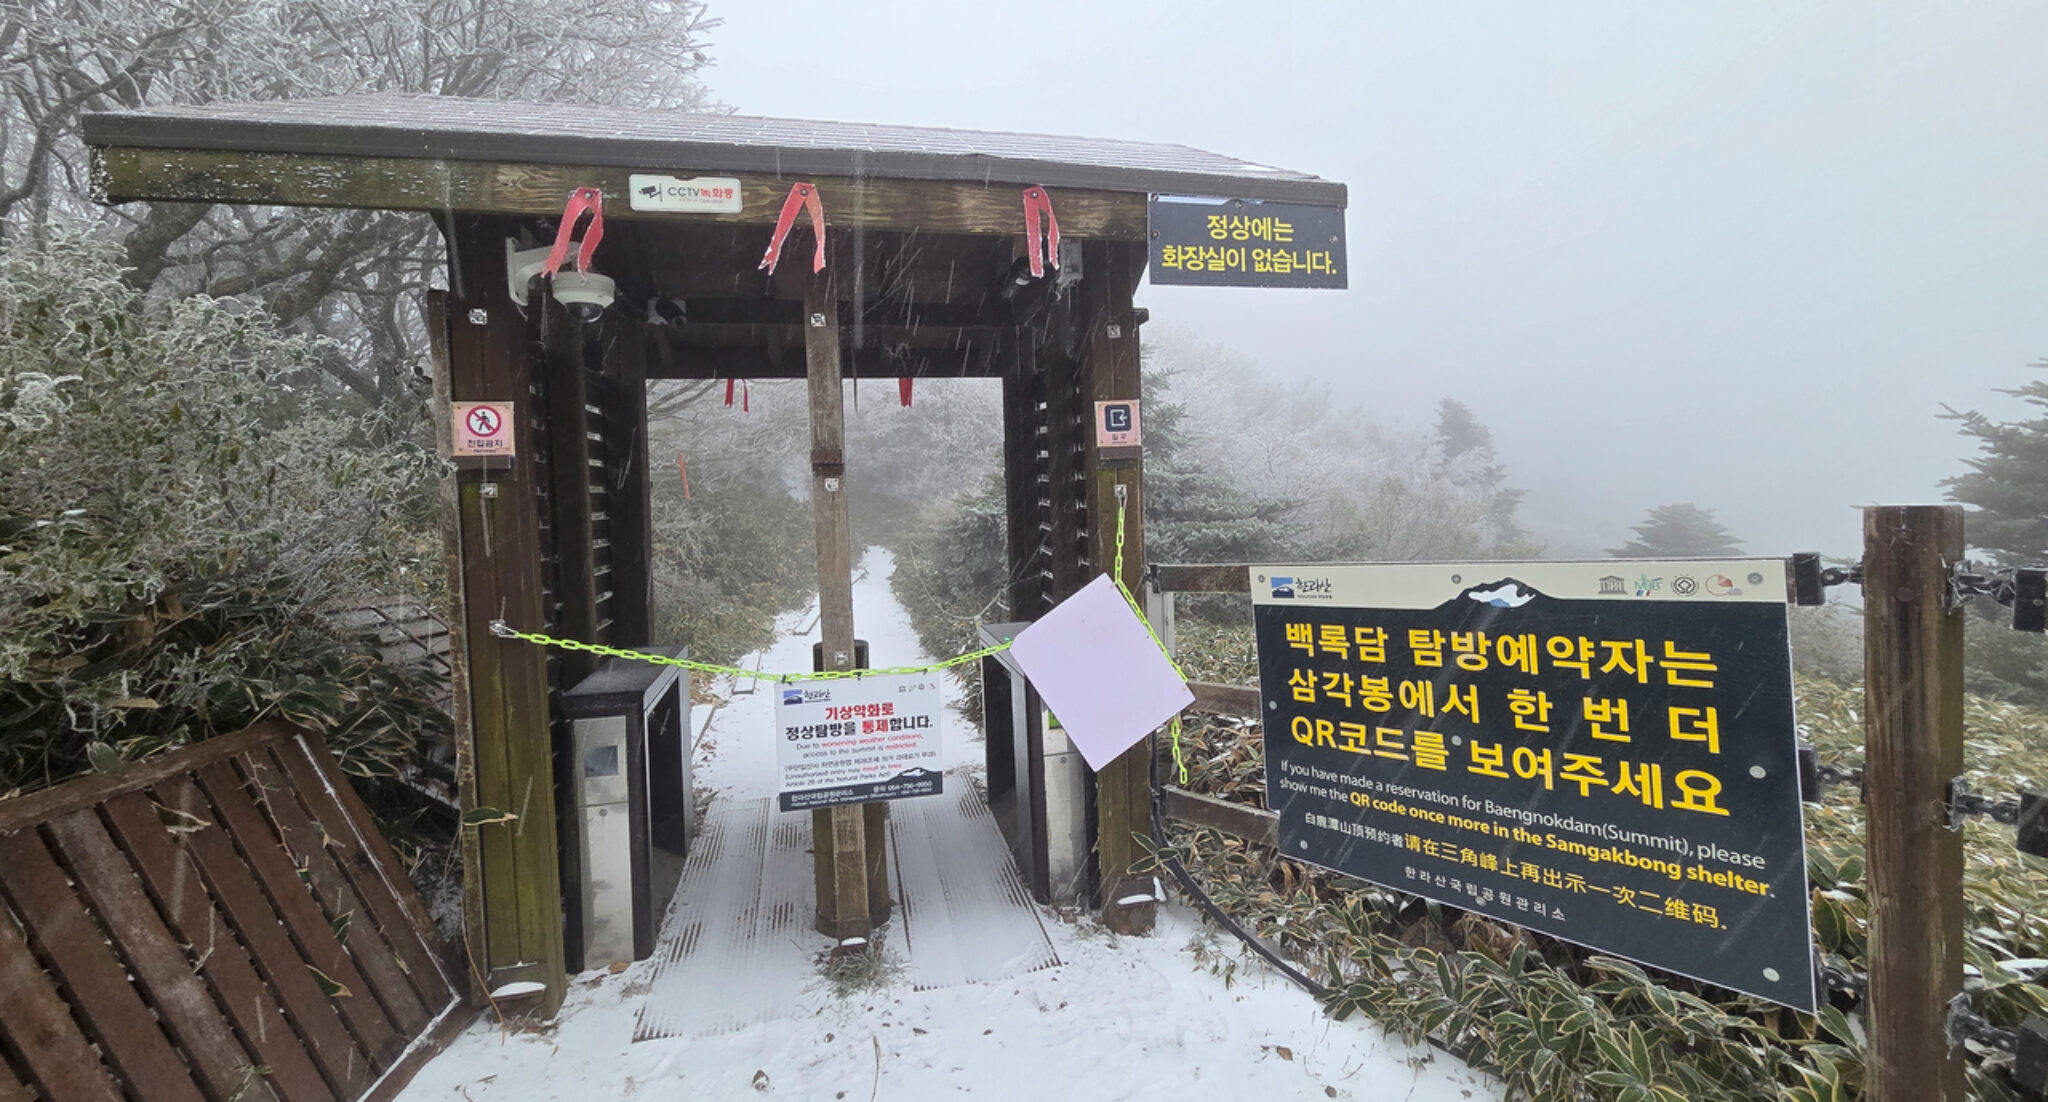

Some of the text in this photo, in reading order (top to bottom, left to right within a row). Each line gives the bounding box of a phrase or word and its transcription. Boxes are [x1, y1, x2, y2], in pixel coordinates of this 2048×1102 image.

[1207, 214, 1294, 242] 정상에는
[1161, 244, 1337, 275] 화장실이 없습니다.
[468, 439, 503, 448] 진입금지
[1285, 623, 1718, 688] 백록담 탐방예약자는
[785, 715, 933, 741] 정상탐방을 통제합니다.
[825, 702, 894, 720] 기상악화로
[1288, 668, 1720, 754] 삼각봉에서 한 번 더
[1291, 715, 1730, 816] QR코드를 보여주세요
[1279, 777, 1775, 898] show me the QR code once more in the Samgakbong shelter.
[1281, 759, 1289, 772] If
[1289, 763, 1310, 777] you
[1311, 765, 1338, 783] have
[1340, 773, 1374, 790] made
[1375, 781, 1384, 791] a
[1386, 782, 1459, 807] reservation
[1462, 794, 1482, 812] for
[1697, 843, 1766, 870] please
